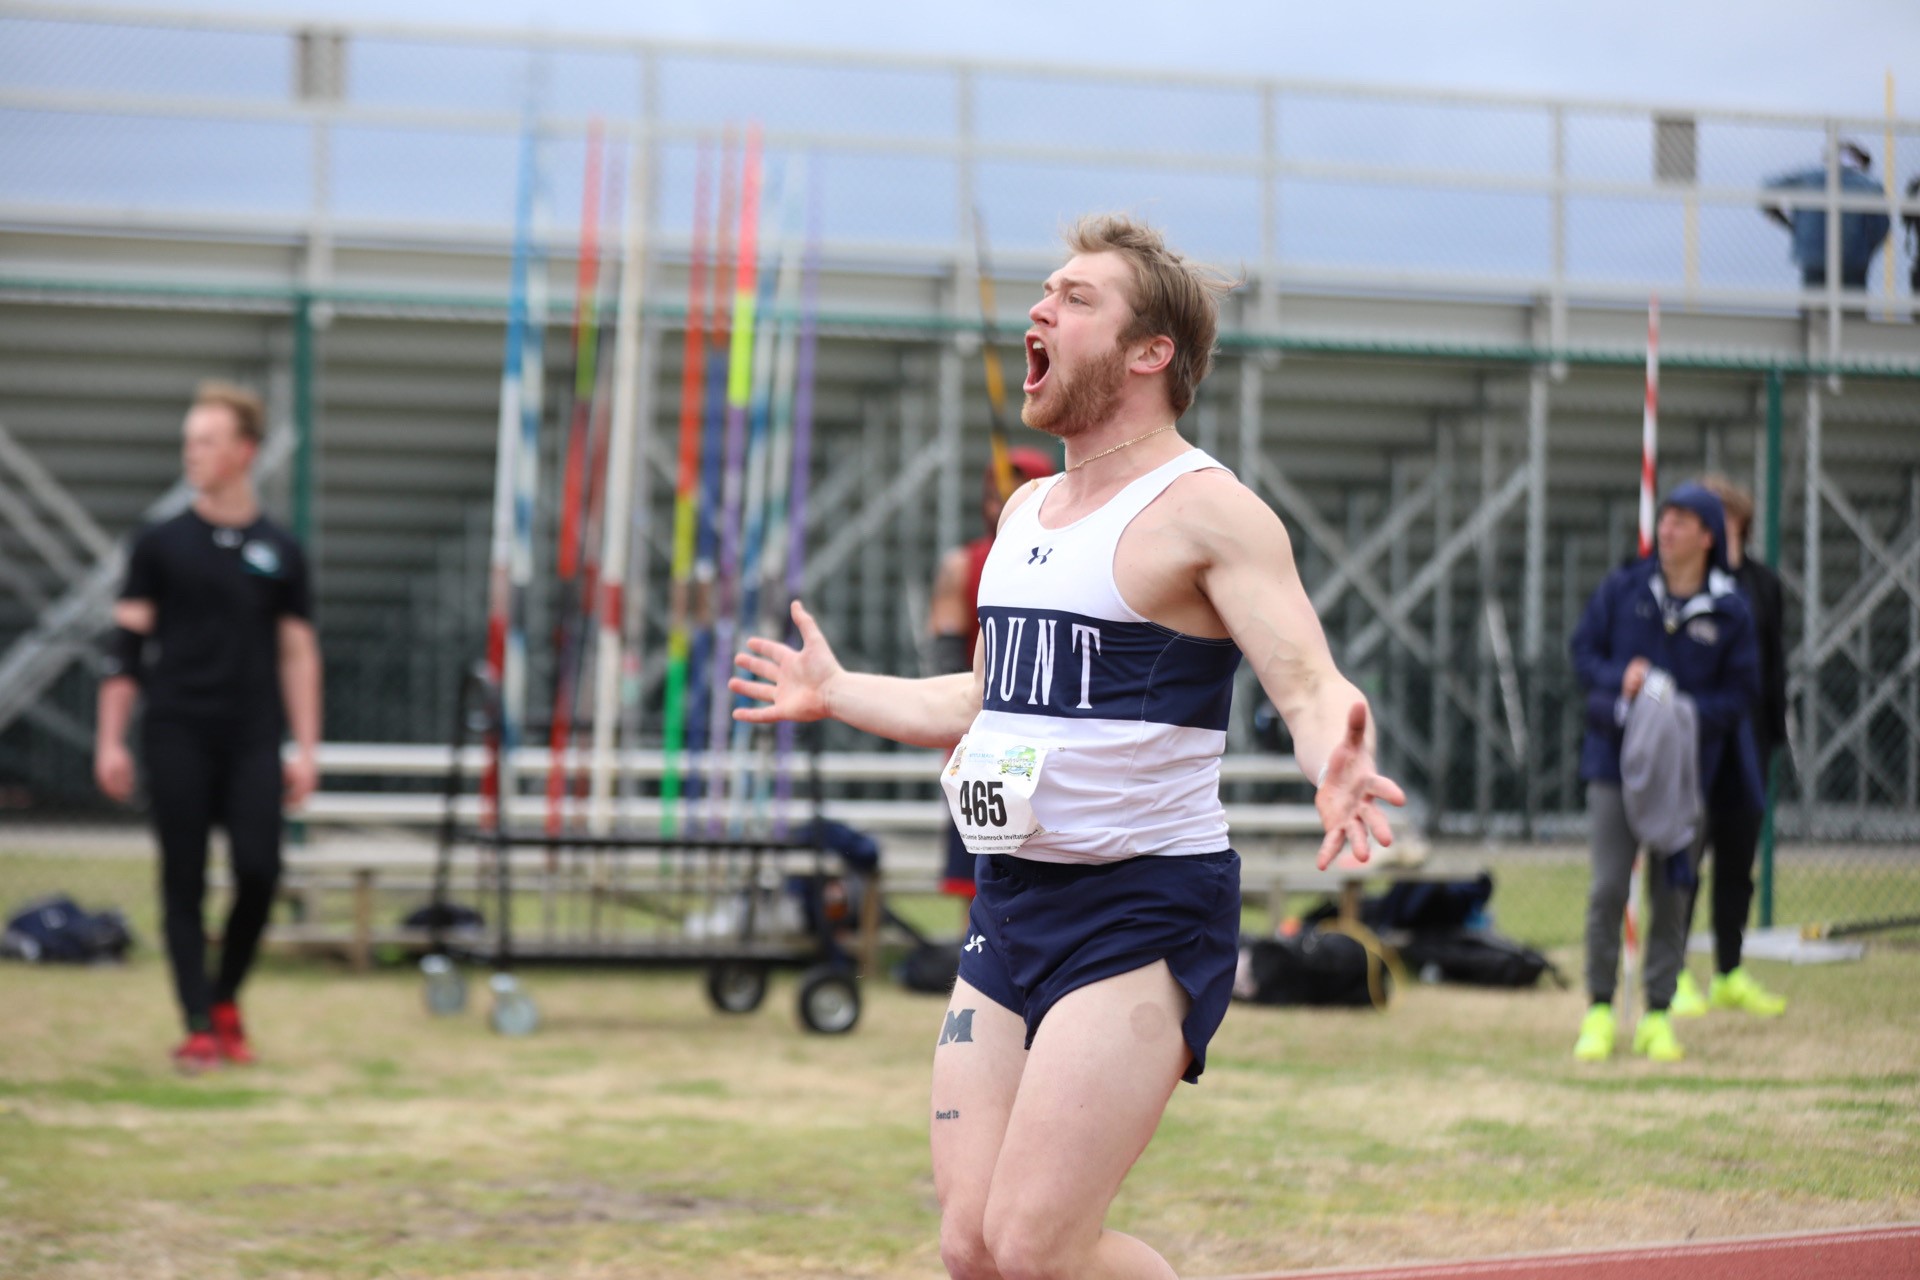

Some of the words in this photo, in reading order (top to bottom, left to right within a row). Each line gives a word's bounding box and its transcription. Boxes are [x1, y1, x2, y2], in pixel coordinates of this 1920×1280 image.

[978, 616, 1101, 709] OUNT
[960, 780, 1008, 827] 465
[939, 1009, 976, 1046] M
[936, 1110, 951, 1120] Send
